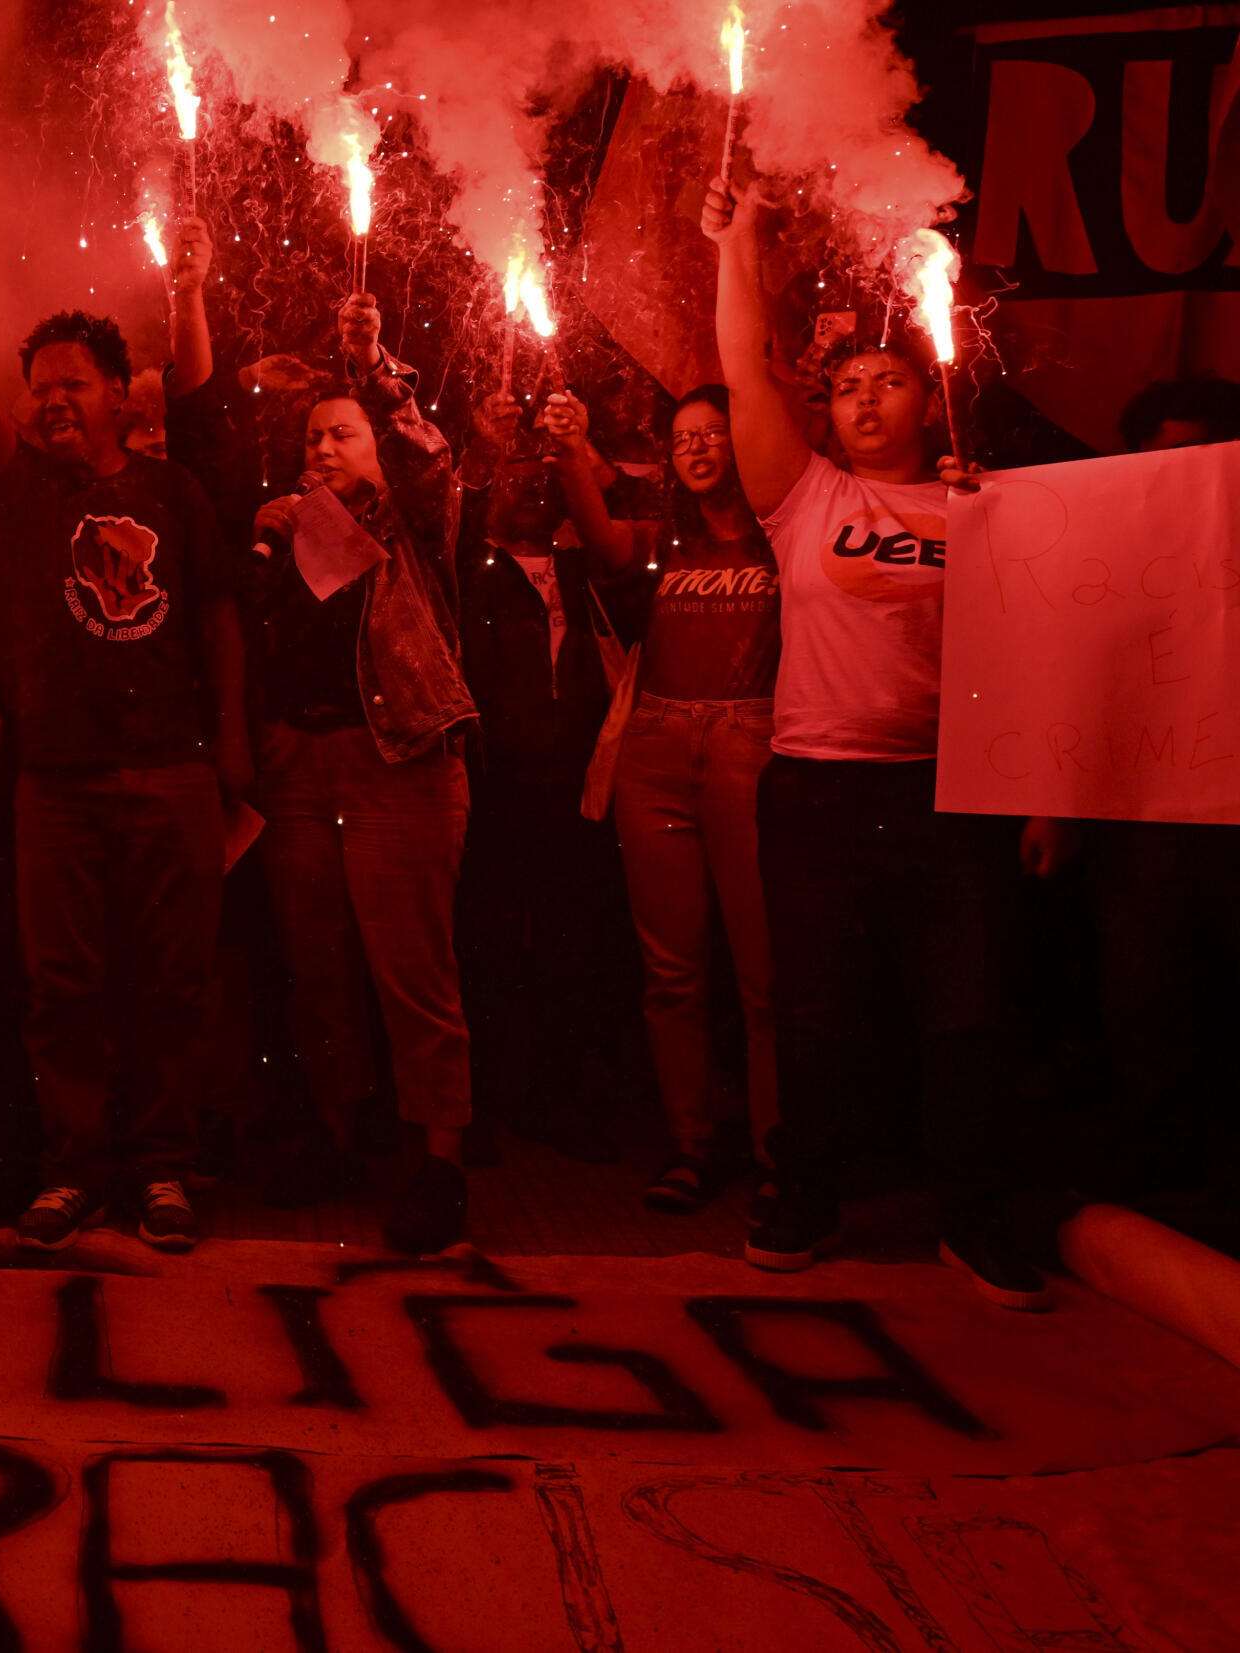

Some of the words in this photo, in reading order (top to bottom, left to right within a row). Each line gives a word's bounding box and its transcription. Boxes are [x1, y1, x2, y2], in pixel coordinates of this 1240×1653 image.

[971, 58, 1240, 276] RU
[64, 588, 87, 623] RAIZ
[86, 617, 105, 637] DA
